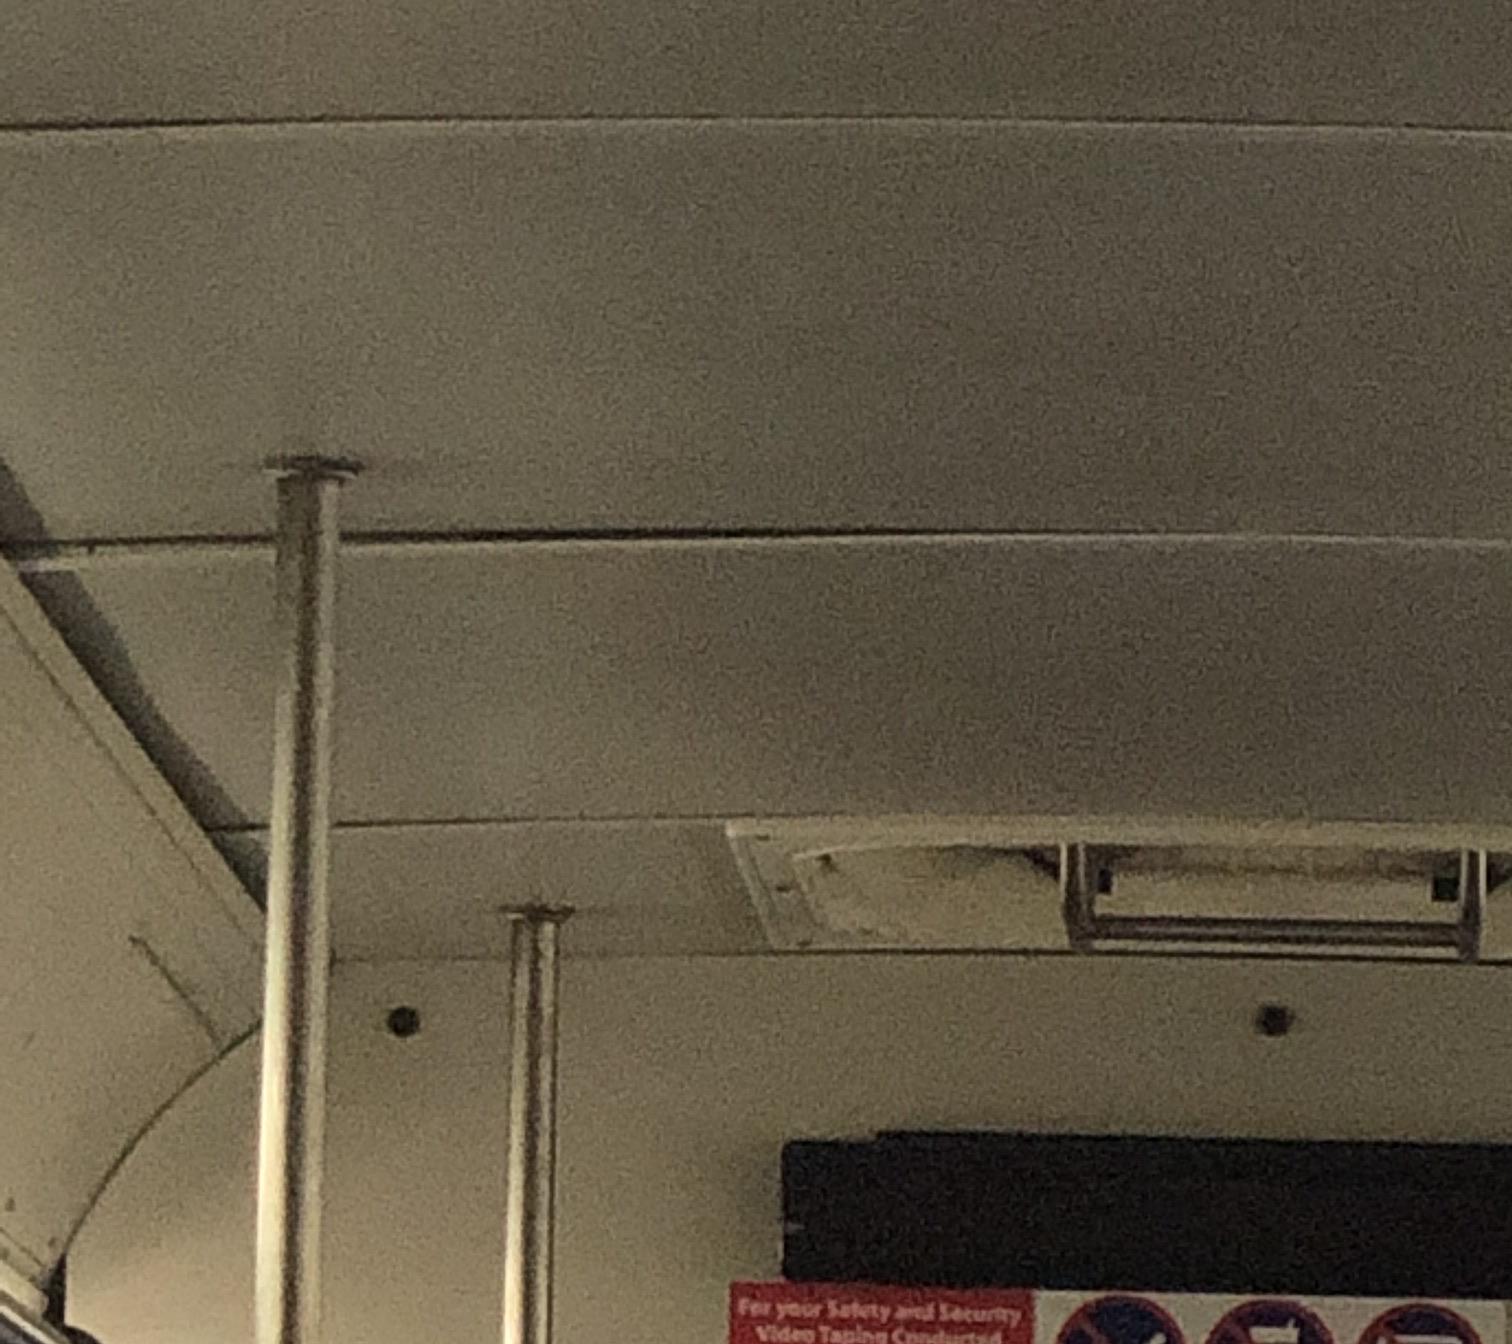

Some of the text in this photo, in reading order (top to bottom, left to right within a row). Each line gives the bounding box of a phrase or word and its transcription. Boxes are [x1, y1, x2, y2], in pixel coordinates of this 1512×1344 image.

[739, 1299, 1022, 1328] For your Safety and Security
[756, 1326, 815, 1344] Video
